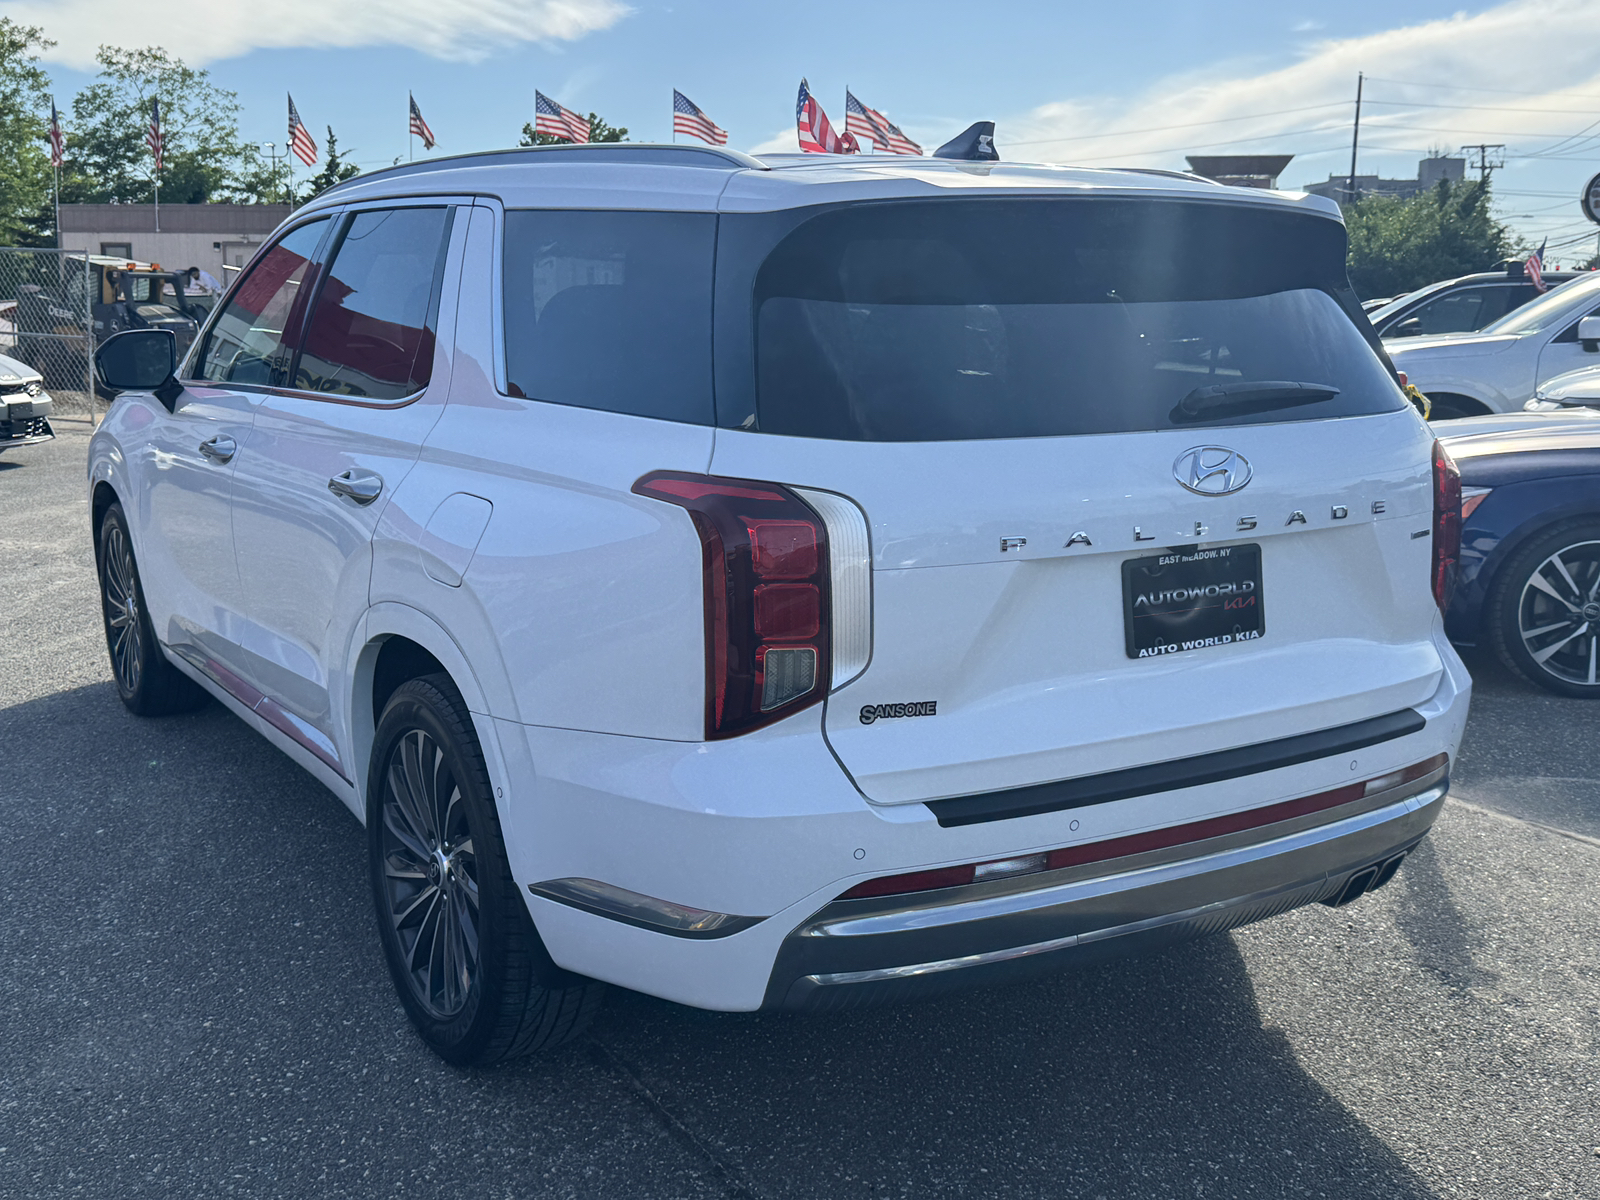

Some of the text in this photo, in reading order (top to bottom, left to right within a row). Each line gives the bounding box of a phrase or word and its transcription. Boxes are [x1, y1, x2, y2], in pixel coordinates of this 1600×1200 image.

[48, 304, 75, 320] DEERE
[1000, 500, 1387, 552] PALISADE
[1158, 554, 1181, 566] EAST
[1219, 548, 1232, 558] NY
[1133, 579, 1255, 608] AUTOWORLD
[1223, 595, 1256, 611] KIA
[1138, 629, 1260, 658] AUTO WORLD KIA
[859, 701, 937, 725] SANSONE
